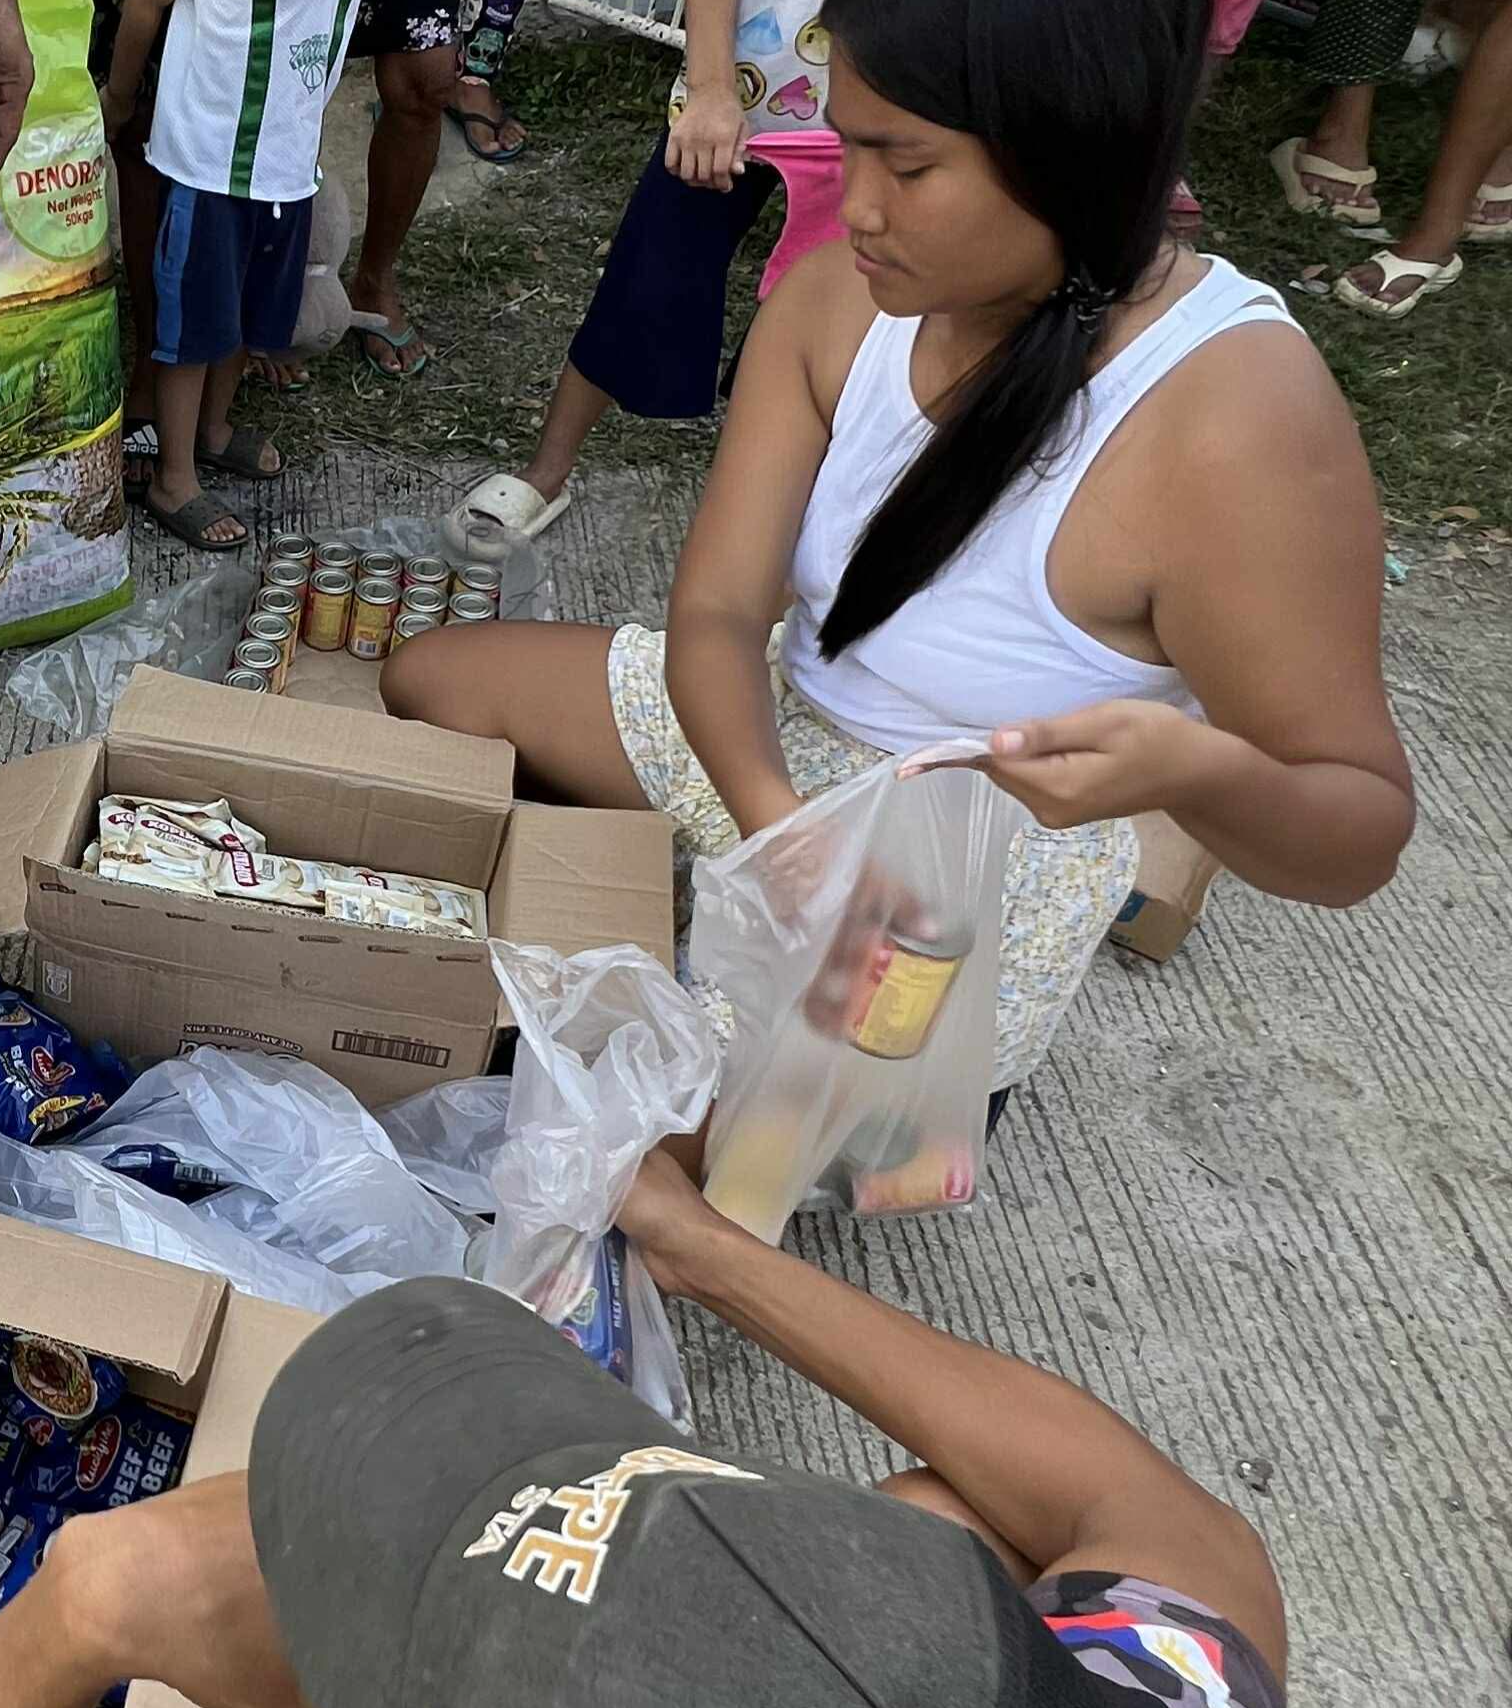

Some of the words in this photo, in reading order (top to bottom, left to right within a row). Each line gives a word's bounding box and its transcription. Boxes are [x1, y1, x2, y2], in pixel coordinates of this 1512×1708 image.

[182, 1023, 208, 1034] MIX
[261, 1033, 303, 1054] CREAMY
[140, 1431, 177, 1494] BEEF
